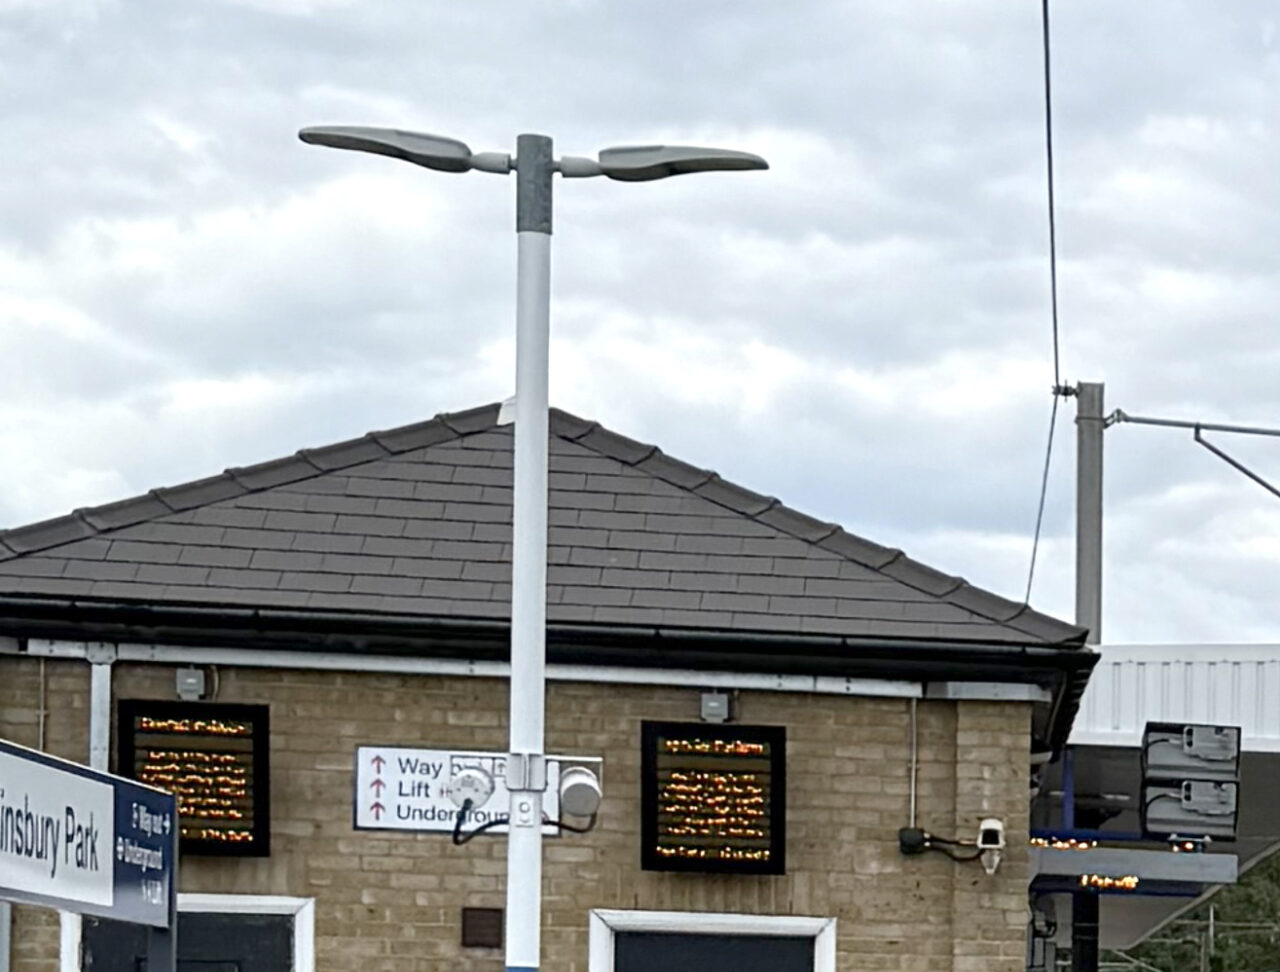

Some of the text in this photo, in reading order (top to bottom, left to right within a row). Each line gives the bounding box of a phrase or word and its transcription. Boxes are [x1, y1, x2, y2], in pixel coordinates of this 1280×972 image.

[397, 757, 444, 779] Way
[398, 780, 431, 798] Lift
[65, 805, 99, 872] Park
